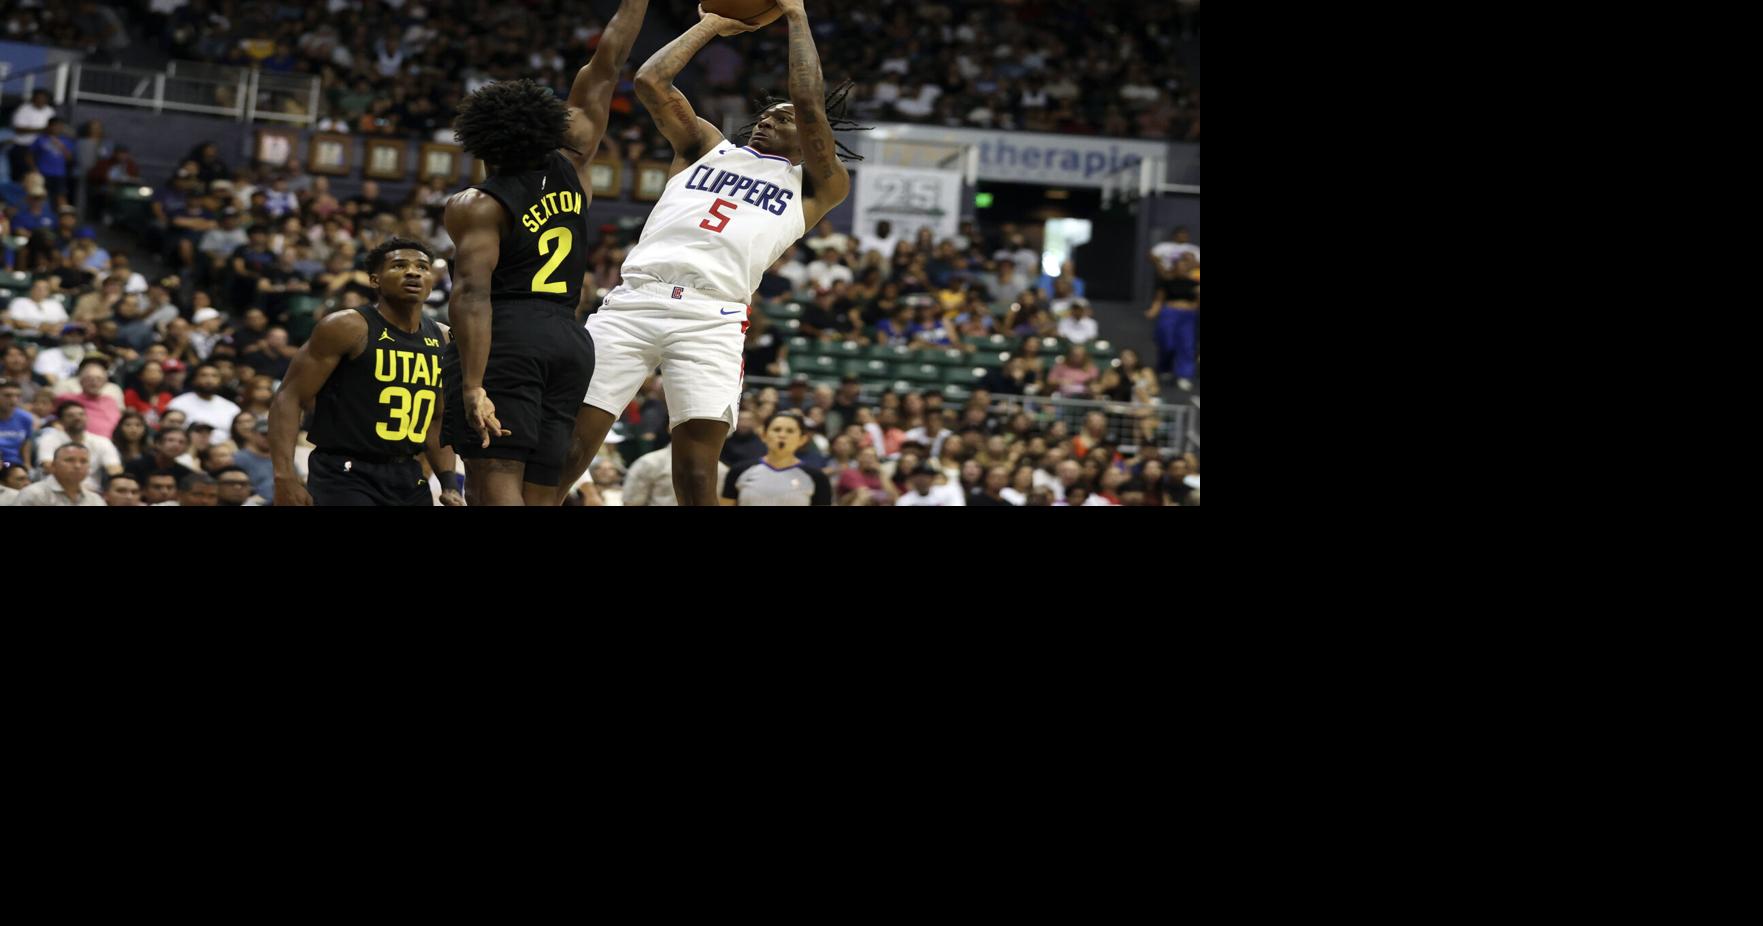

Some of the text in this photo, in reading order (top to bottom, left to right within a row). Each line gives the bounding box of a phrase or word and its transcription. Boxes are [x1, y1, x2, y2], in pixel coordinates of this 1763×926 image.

[521, 190, 582, 233] SEXTON
[684, 163, 793, 216] CLIPPERS
[699, 198, 738, 233] 5
[531, 226, 573, 293] 2
[374, 348, 443, 388] UTAH
[375, 386, 436, 444] 30
